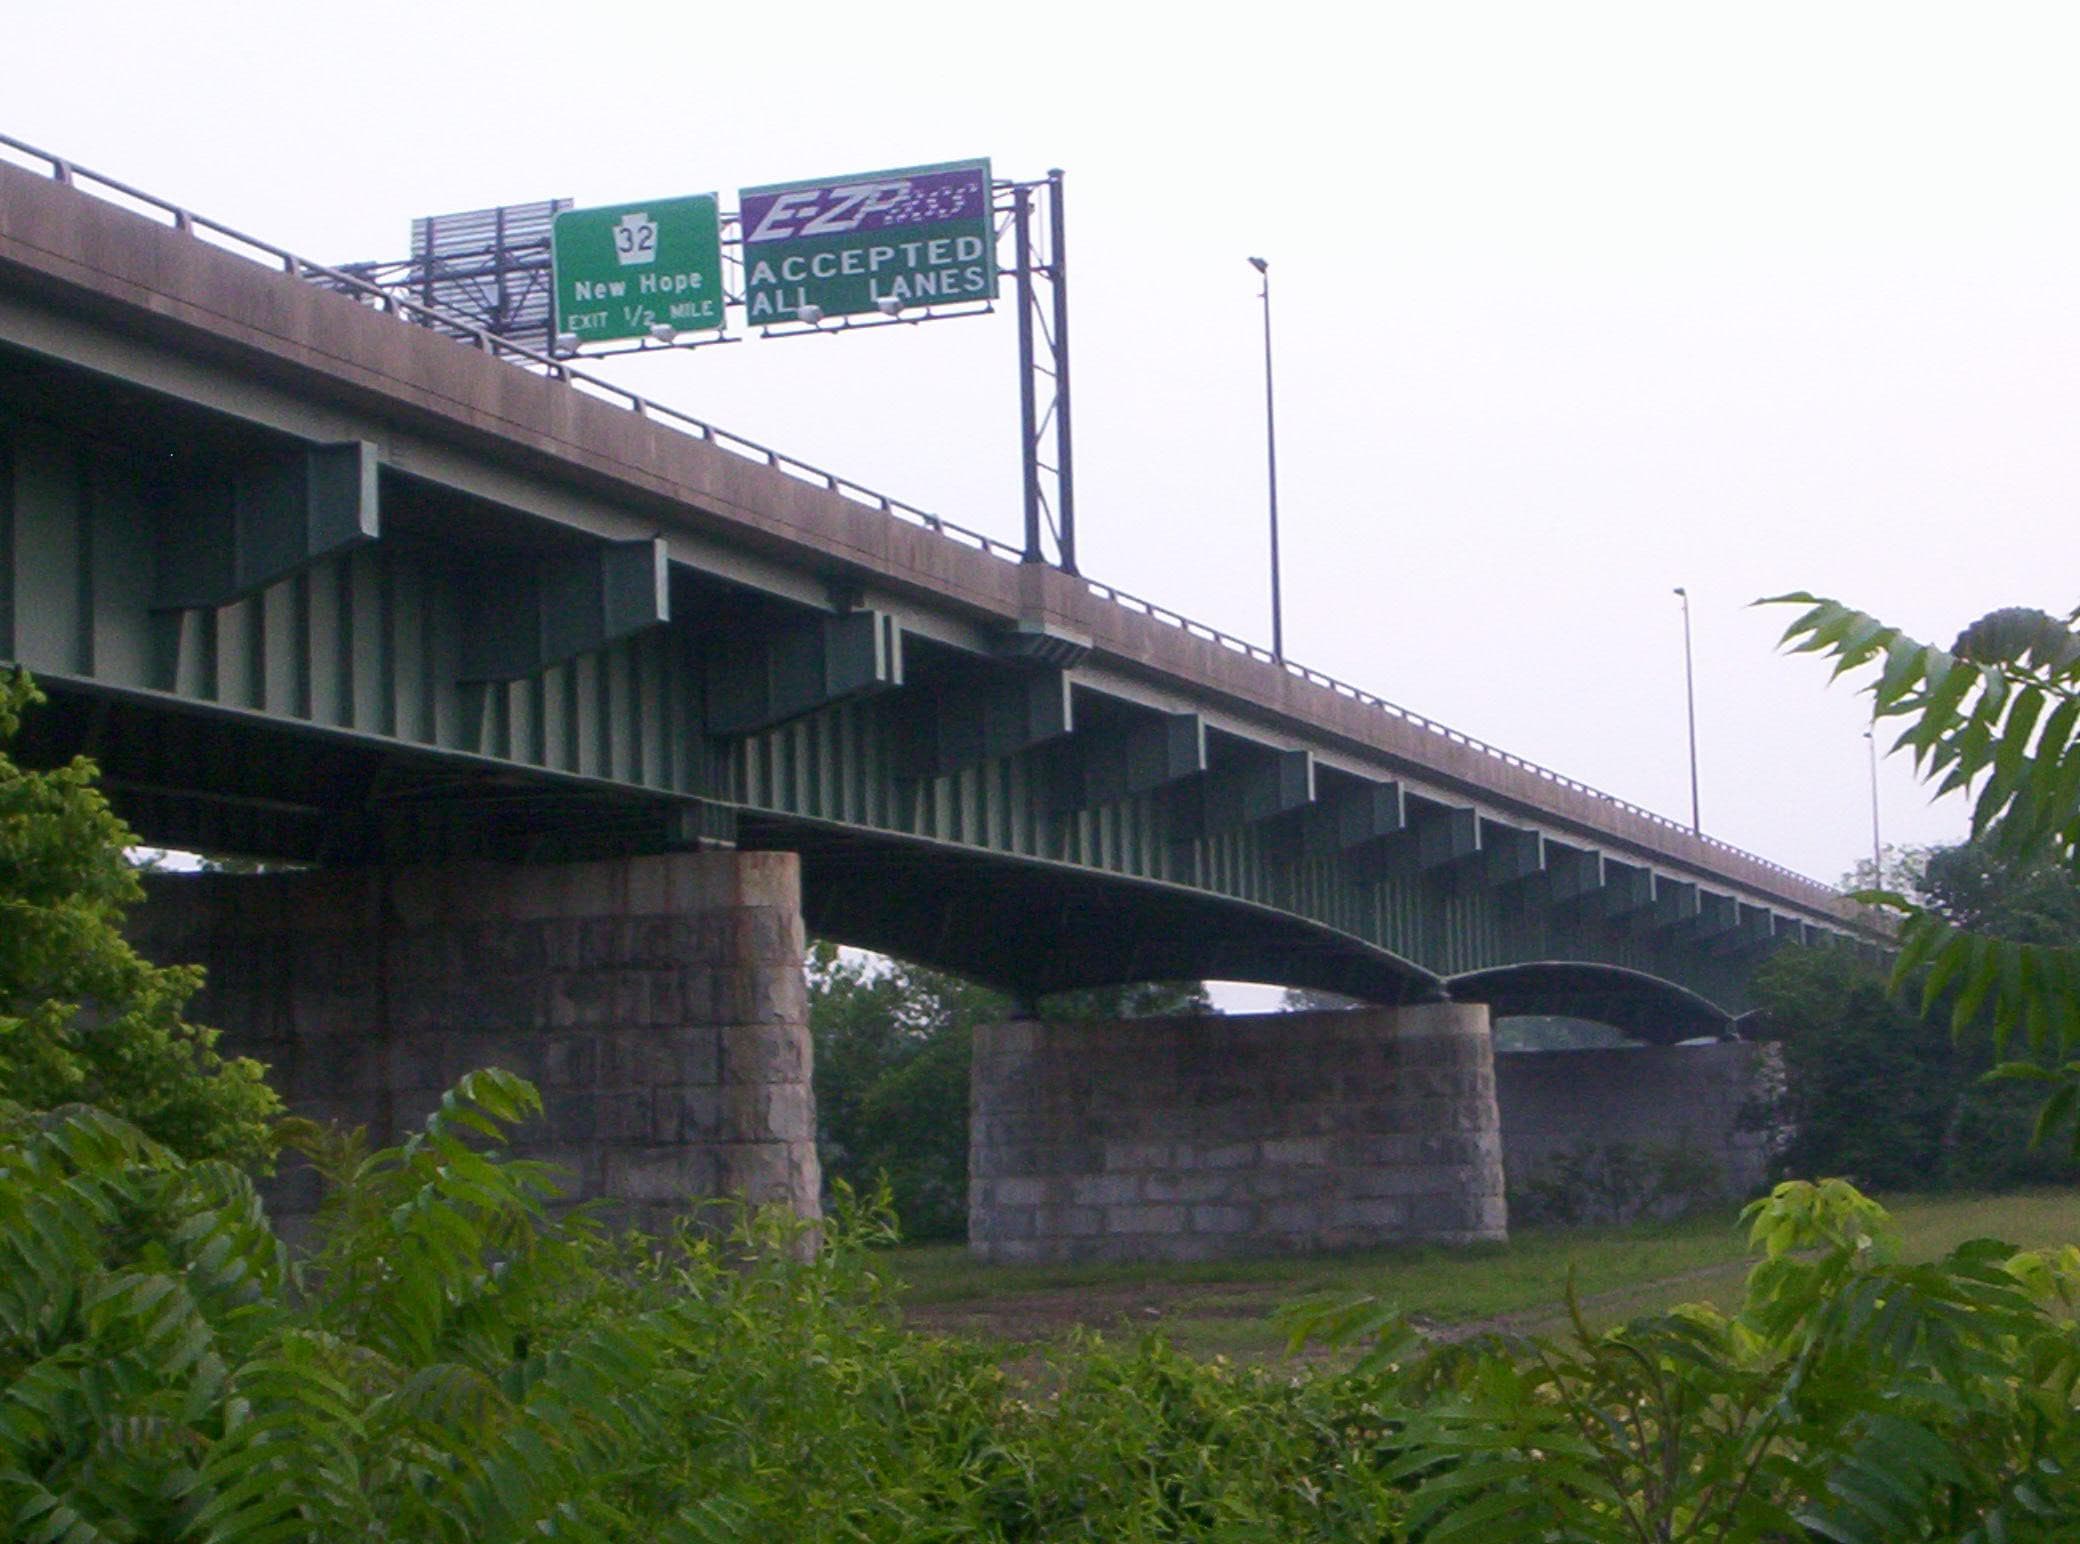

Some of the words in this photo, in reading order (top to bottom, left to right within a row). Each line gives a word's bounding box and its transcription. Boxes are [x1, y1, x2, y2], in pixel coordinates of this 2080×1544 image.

[619, 226, 653, 253] 32
[751, 236, 983, 286] ACCEPTED
[574, 281, 626, 301] New
[639, 272, 702, 294] Hope
[751, 287, 807, 316] ALL
[870, 267, 986, 303] LANES
[568, 312, 608, 331] EXIT
[623, 305, 656, 327] 1/2
[669, 300, 714, 319] MILE
